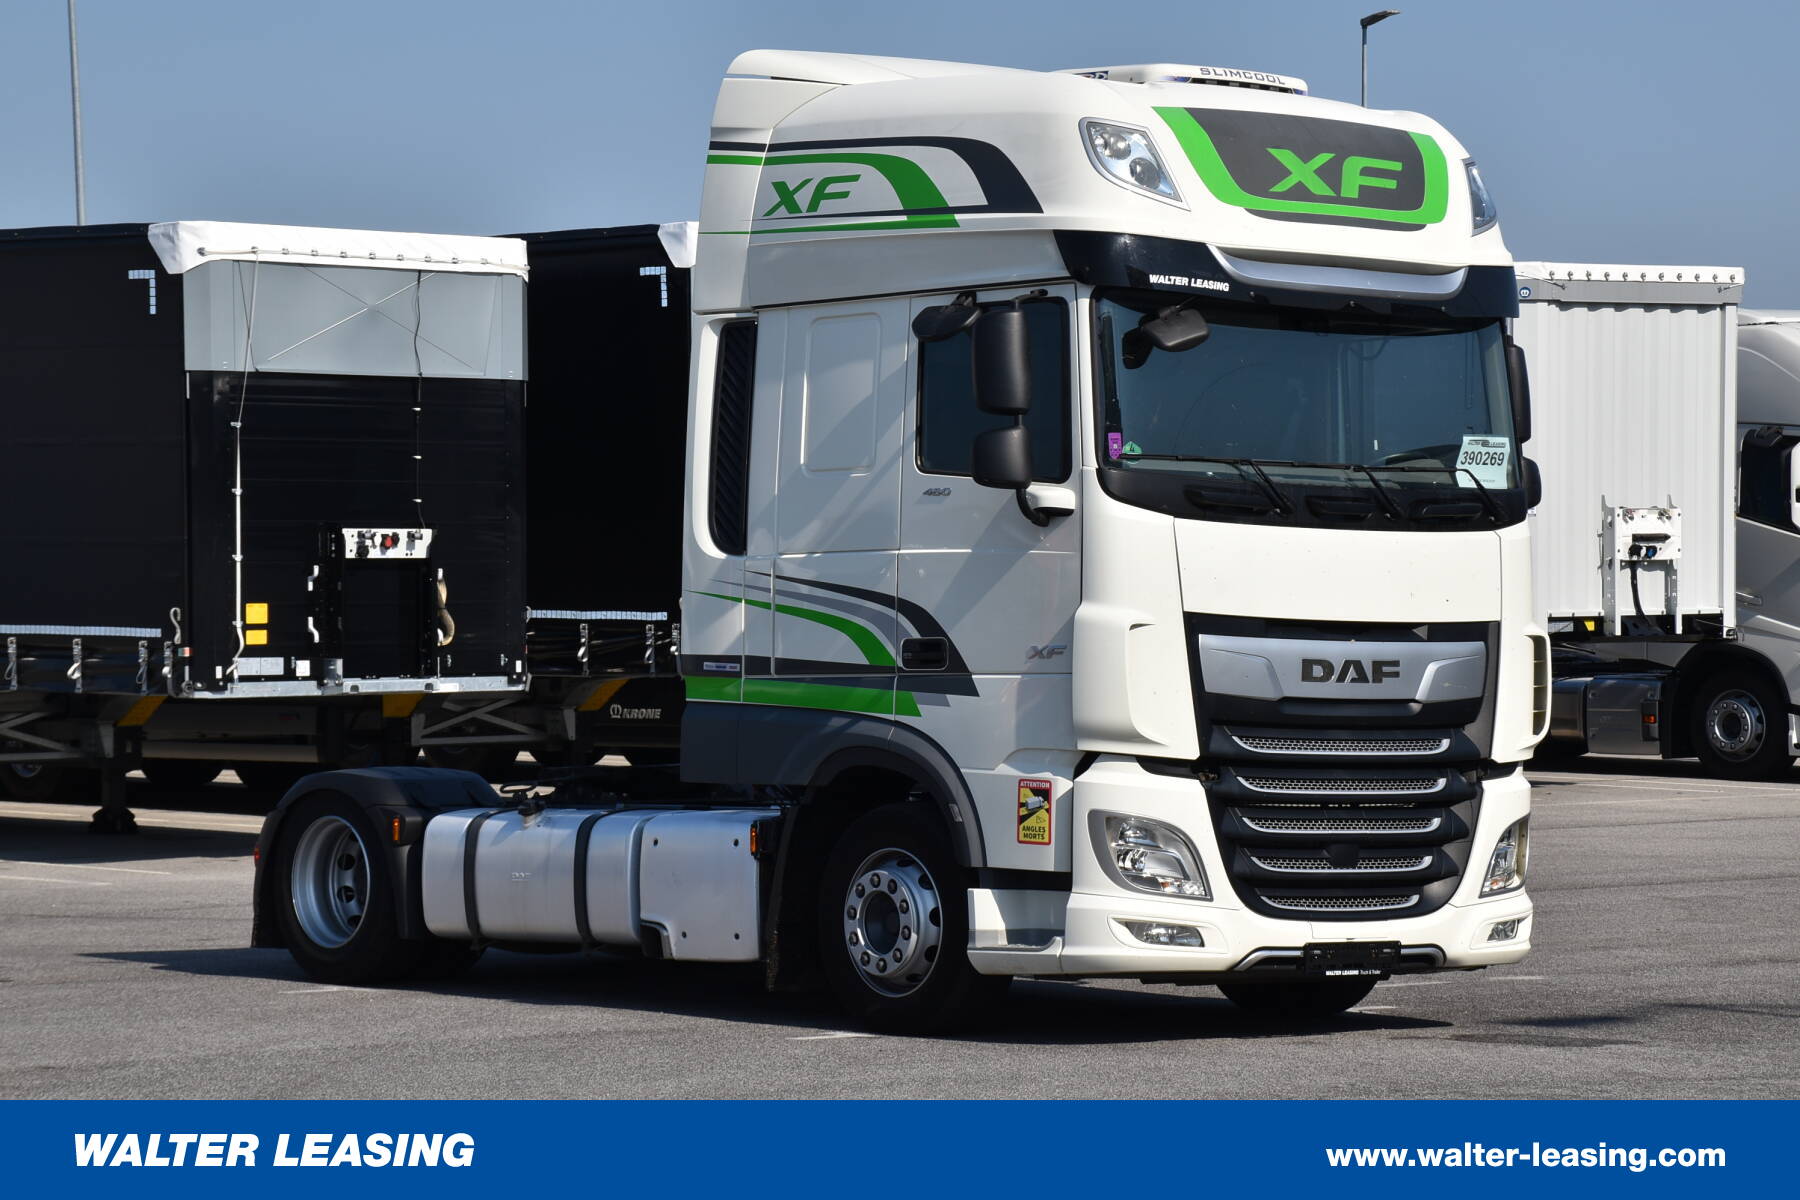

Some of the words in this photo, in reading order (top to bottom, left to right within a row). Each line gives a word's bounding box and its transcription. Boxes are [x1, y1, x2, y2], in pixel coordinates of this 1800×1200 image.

[1200, 67, 1286, 85] SLIMCOOL
[1266, 148, 1403, 199] XF
[763, 174, 862, 217] XF
[1149, 274, 1189, 286] WALTER
[1190, 278, 1230, 292] LEASING
[1460, 451, 1505, 466] 390269
[1027, 645, 1068, 660] XF
[1301, 659, 1401, 684] DAF
[622, 708, 662, 719] KRONE
[1020, 780, 1050, 788] ATTENTION
[1023, 832, 1045, 840] MORTS
